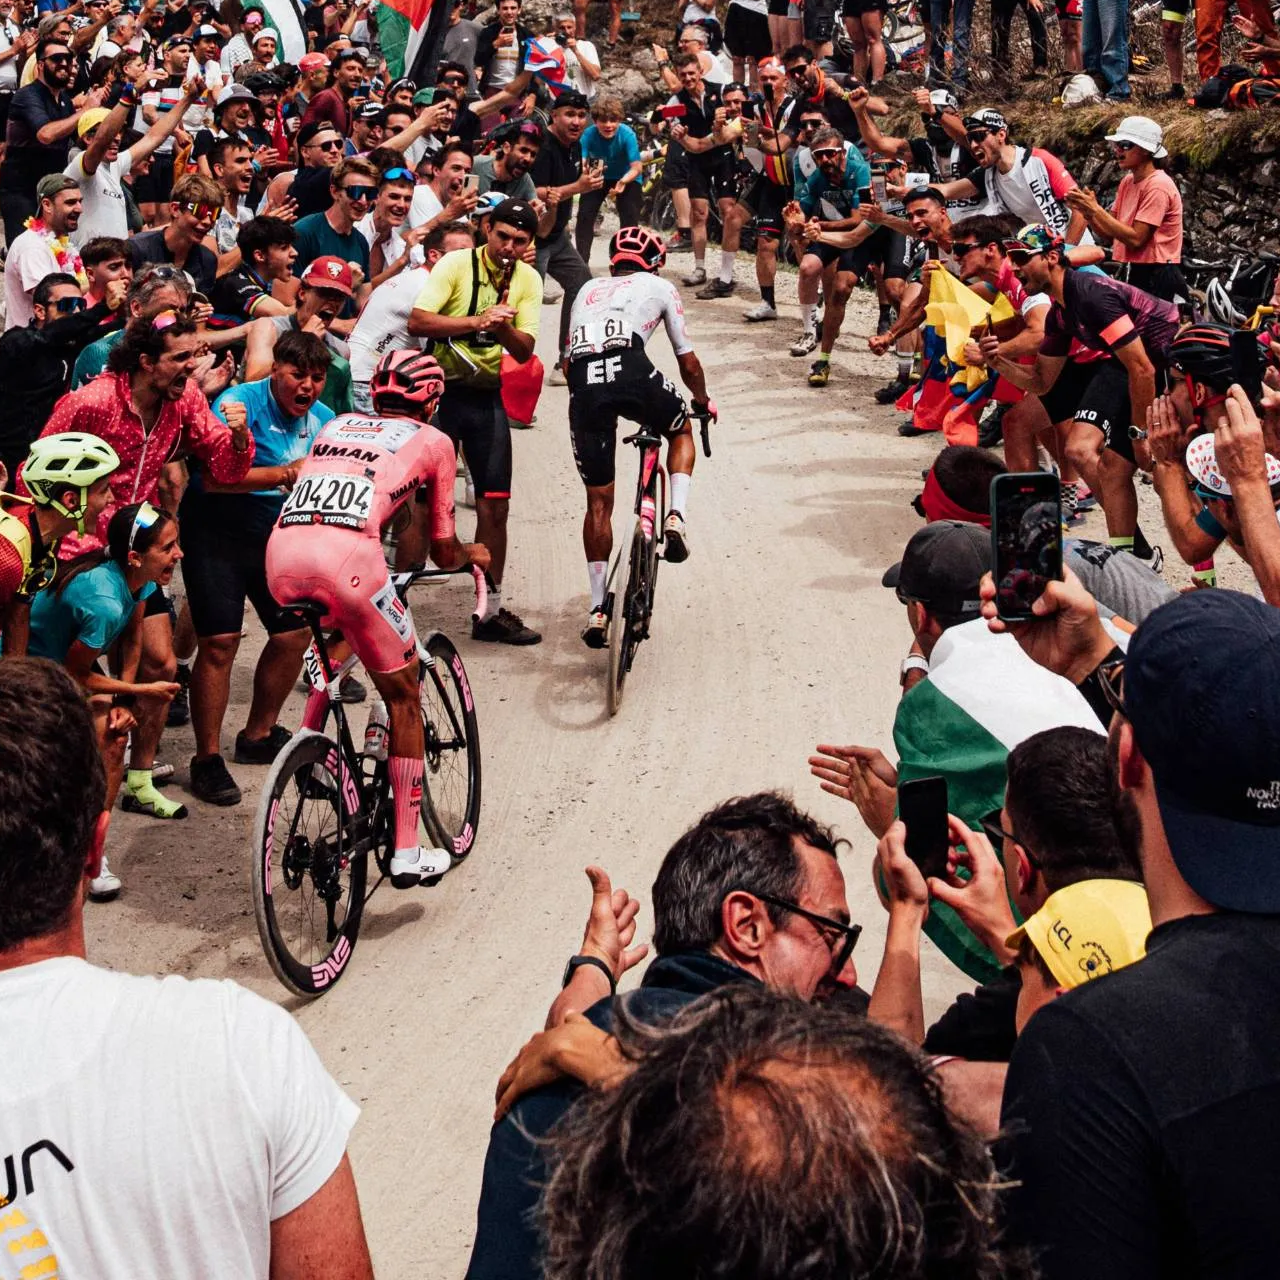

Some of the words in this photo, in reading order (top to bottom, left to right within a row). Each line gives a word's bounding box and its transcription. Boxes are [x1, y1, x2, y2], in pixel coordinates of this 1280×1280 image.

[604, 318, 625, 338] 61
[587, 355, 623, 385] EF
[322, 478, 371, 515] 204
[282, 513, 312, 524] TUDOR
[323, 515, 359, 528] TUDOR
[1053, 919, 1073, 951] LCL
